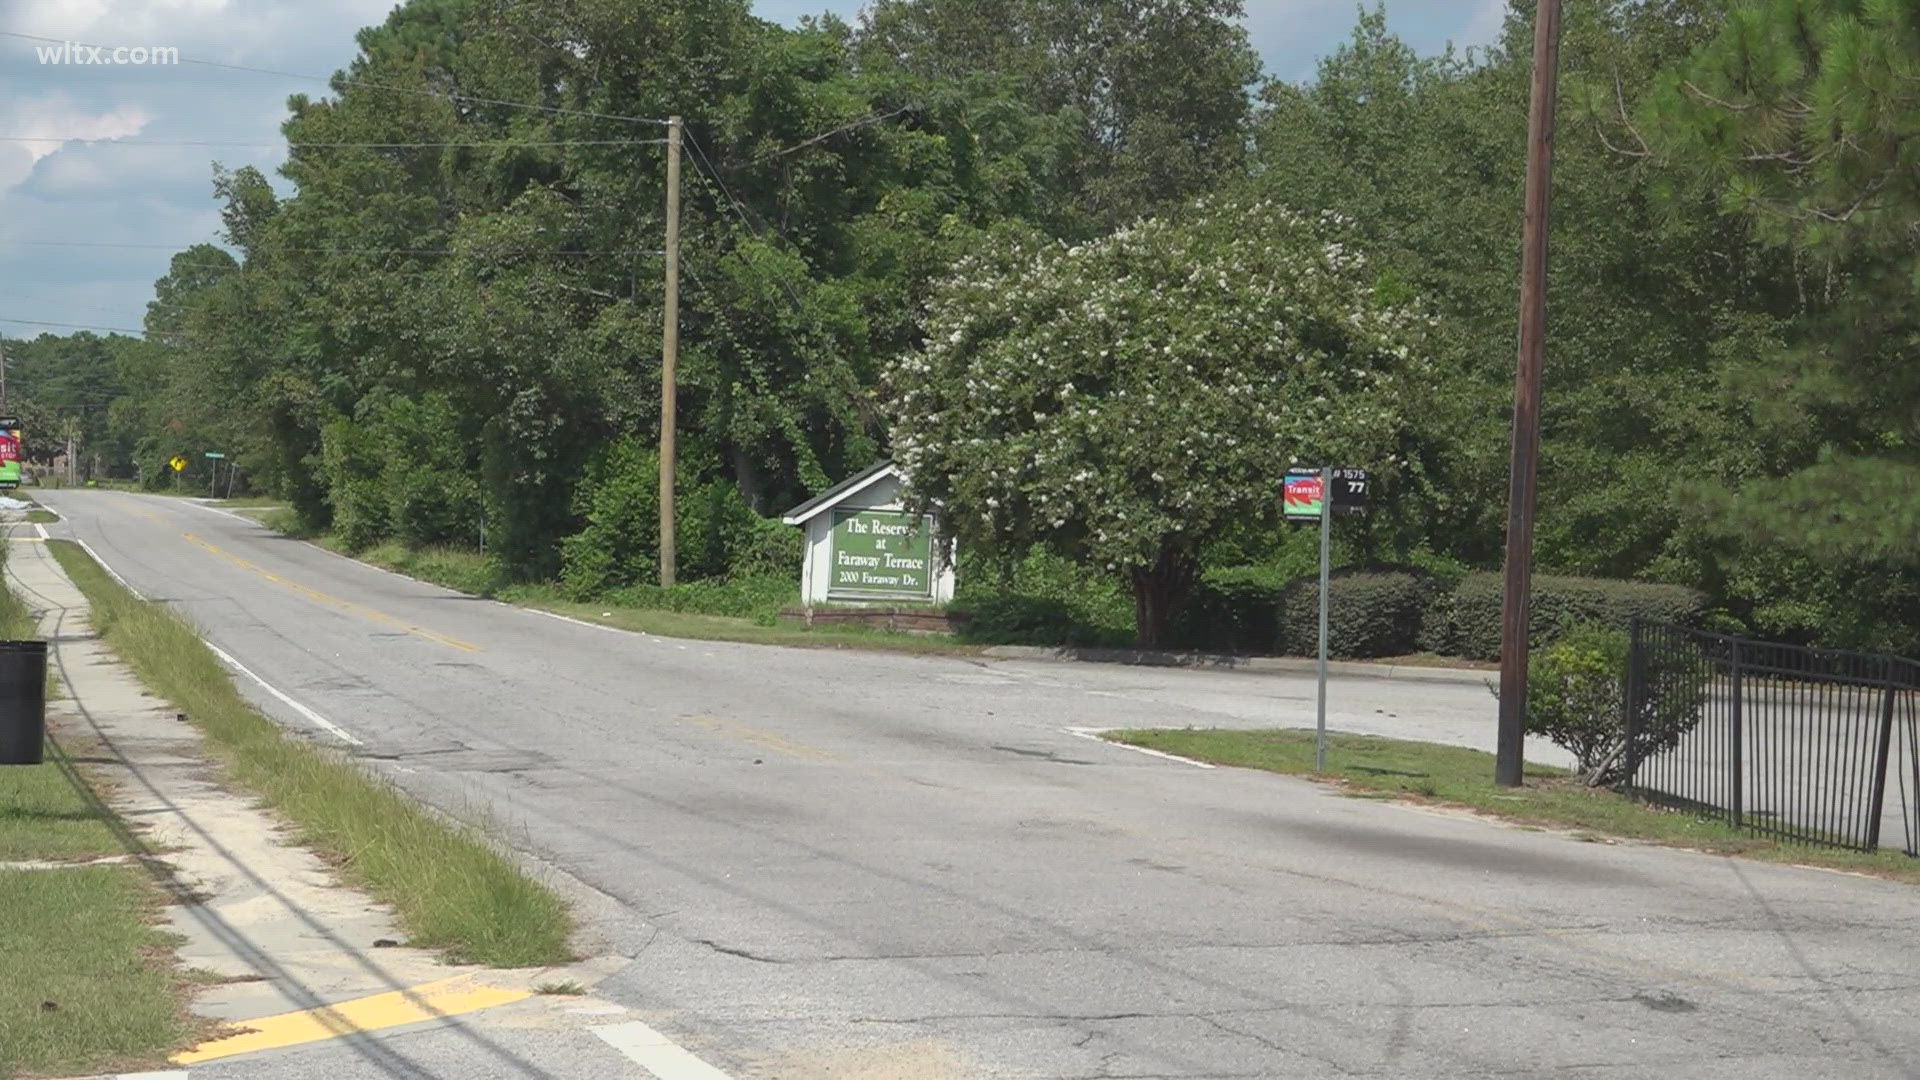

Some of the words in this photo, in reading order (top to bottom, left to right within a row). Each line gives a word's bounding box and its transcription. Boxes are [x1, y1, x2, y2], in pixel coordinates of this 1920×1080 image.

[1343, 469, 1365, 479] 1575
[1288, 485, 1320, 494] Transit
[1347, 481, 1365, 493] 77
[846, 518, 868, 533] The
[871, 519, 918, 536] Reserv
[875, 538, 886, 549] at
[837, 550, 880, 570] Faraway
[883, 552, 923, 569] Terrace
[839, 571, 859, 583] 2000
[862, 571, 899, 587] Faraway
[902, 573, 919, 586] Dr.
